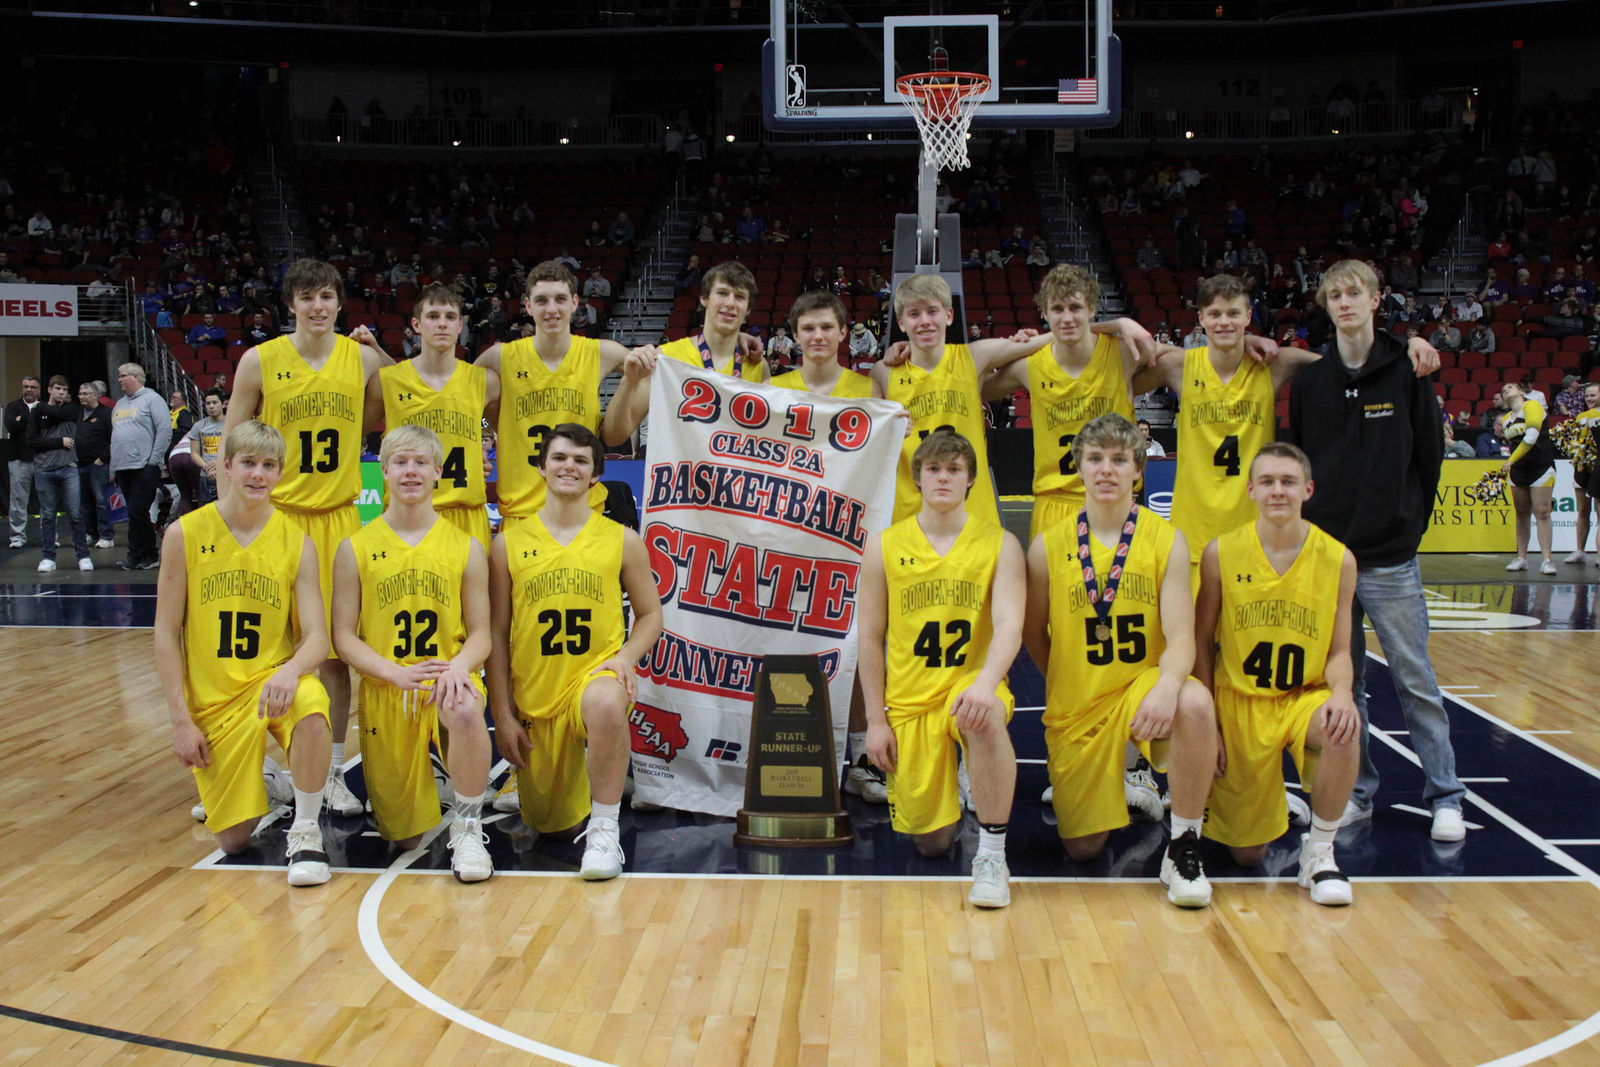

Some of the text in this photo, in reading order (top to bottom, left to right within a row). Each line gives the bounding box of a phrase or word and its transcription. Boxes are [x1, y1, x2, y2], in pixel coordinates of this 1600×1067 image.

[0, 299, 73, 318] EELS
[280, 391, 355, 427] BOYDEN-HULL
[515, 387, 586, 421] BOYDEN-HULL
[677, 377, 873, 452] 2019
[299, 429, 339, 474] 13
[434, 446, 467, 489] 4
[710, 431, 824, 477] CLASS 2A
[1214, 435, 1240, 477] 4
[646, 461, 867, 556] BASKETBALL
[201, 569, 281, 609] BOYDEN-HULL
[376, 568, 450, 609] BOYDEN-HULL
[524, 568, 604, 607] BOYDEN-HULL
[643, 522, 861, 639] STATE
[901, 579, 984, 615] BOYDEN-HULL
[217, 611, 261, 660] 15
[393, 609, 438, 658] 32
[538, 608, 591, 656] 25
[1085, 613, 1147, 666] 55
[1233, 599, 1318, 640] BOYDEN-HULL
[913, 619, 971, 668] 42
[1243, 641, 1305, 691] 40
[629, 708, 671, 757] HSAA
[760, 743, 822, 753] RUNNER-UP
[775, 731, 807, 741] STATE
[637, 768, 675, 779] ASSOCIATION
[648, 763, 670, 771] SCHOOL
